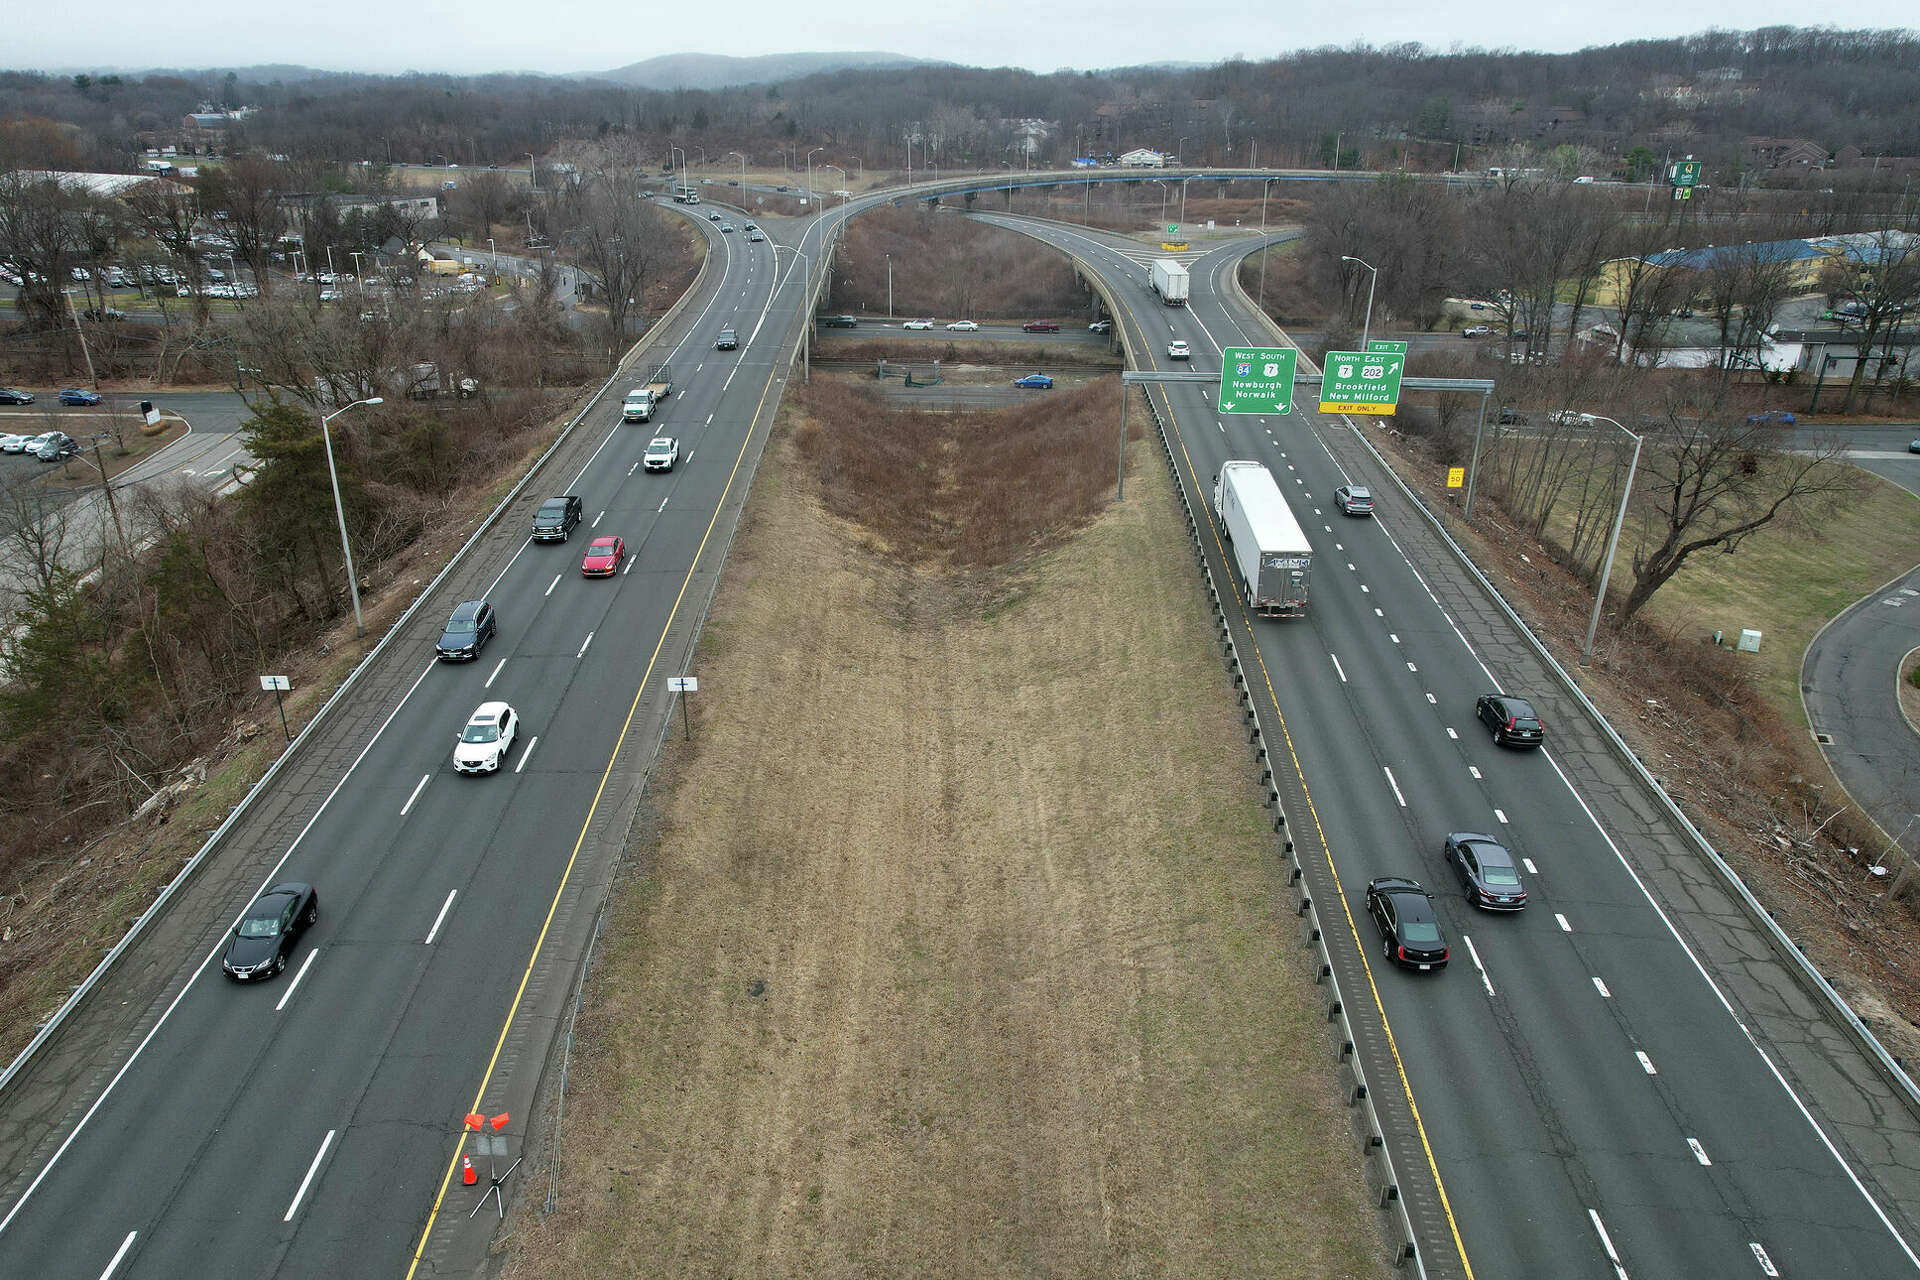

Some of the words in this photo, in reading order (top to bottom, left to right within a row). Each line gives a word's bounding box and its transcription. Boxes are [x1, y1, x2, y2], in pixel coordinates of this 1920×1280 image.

[1235, 352, 1256, 360] WEST
[1260, 352, 1285, 360] SOUTH
[1334, 354, 1360, 362] NORTH
[1365, 355, 1385, 363] EAST
[1238, 366, 1249, 374] 84
[1267, 366, 1274, 374] 7
[1343, 367, 1349, 375] 7
[1363, 368, 1381, 377] 202
[1232, 381, 1282, 390] Newburgh
[1335, 382, 1387, 391] Brookfield
[1329, 392, 1349, 400] New
[1354, 393, 1390, 401] Milford
